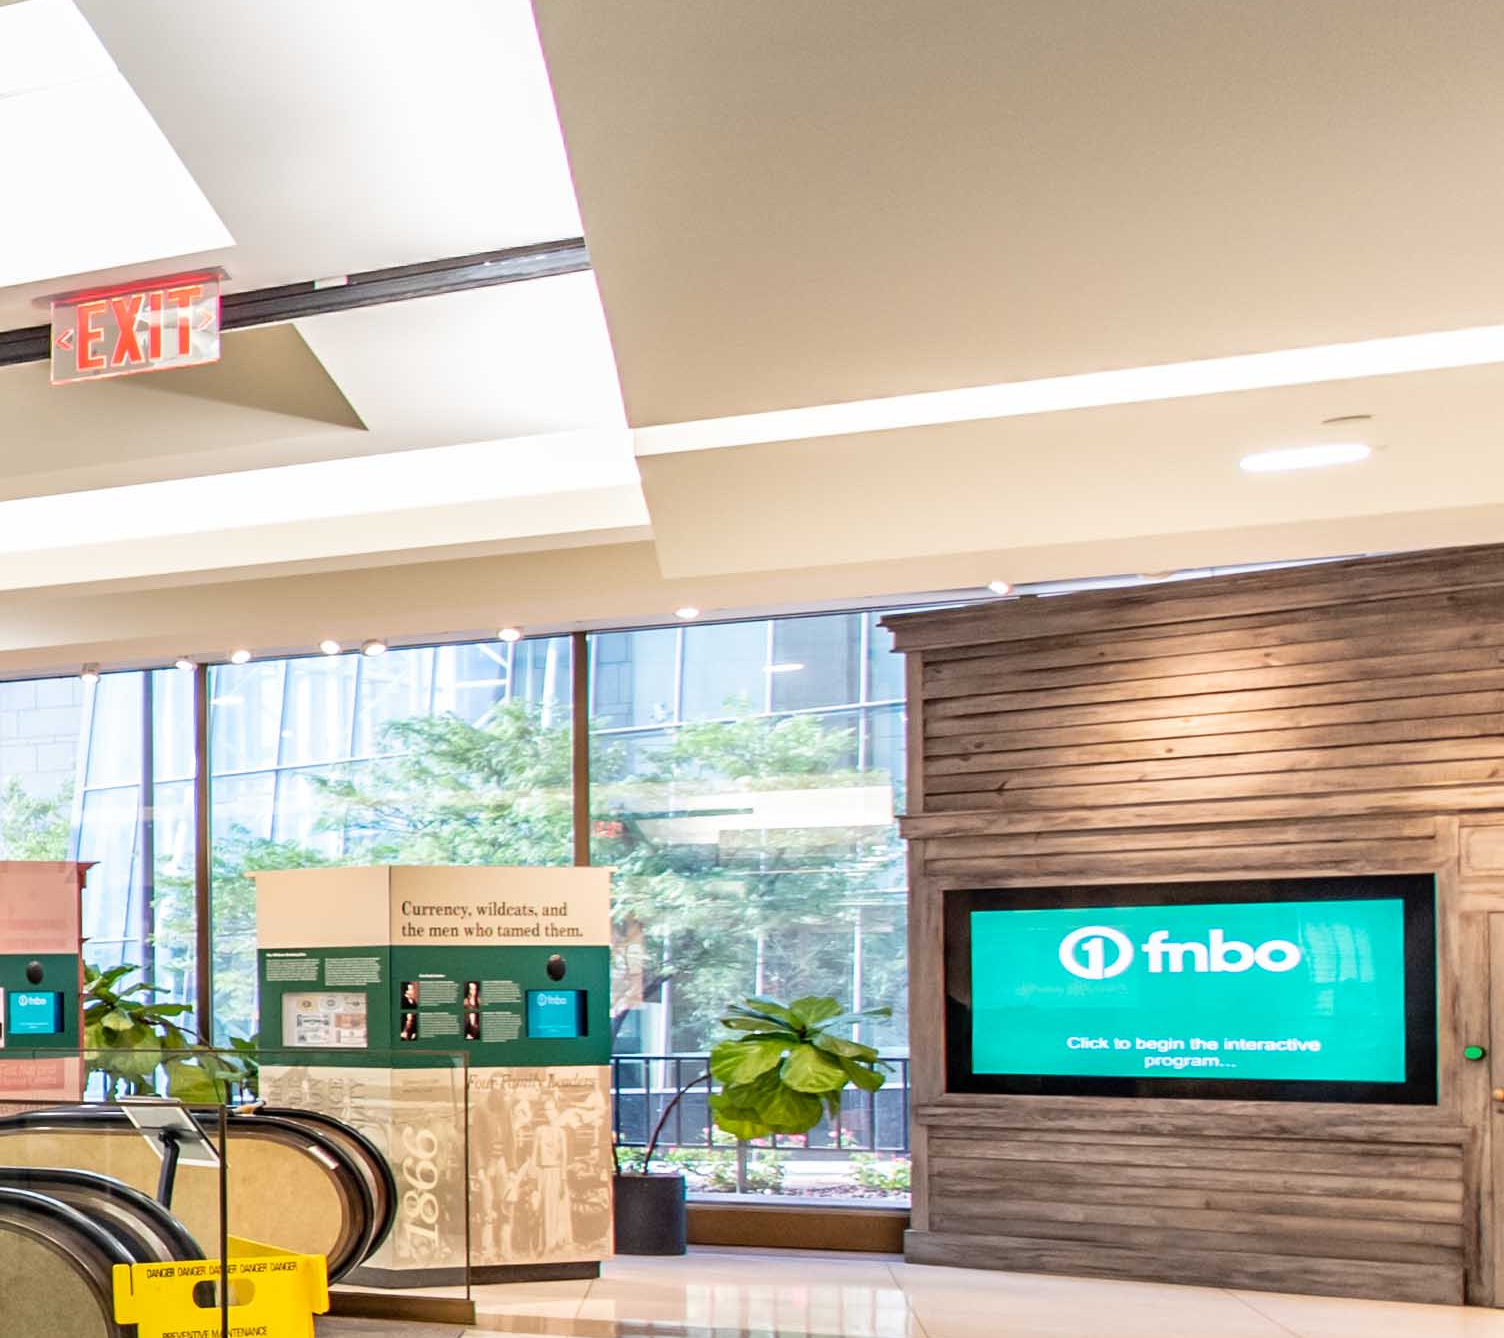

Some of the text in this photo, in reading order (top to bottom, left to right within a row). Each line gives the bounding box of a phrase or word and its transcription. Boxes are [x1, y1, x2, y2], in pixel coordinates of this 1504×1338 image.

[76, 284, 204, 373] EXIT
[401, 900, 568, 922] Currency, wildcats, and
[401, 922, 584, 938] the men who tamed them.
[1141, 928, 1303, 974] fnbo
[1066, 1035, 1321, 1054] Click to begin the interactive
[1143, 1054, 1237, 1070] program...
[401, 1126, 440, 1248] 1866
[146, 1268, 176, 1278] DANGER
[177, 1266, 206, 1277] DANGER
[240, 1263, 268, 1273] DANGER
[270, 1261, 298, 1272] DANGER
